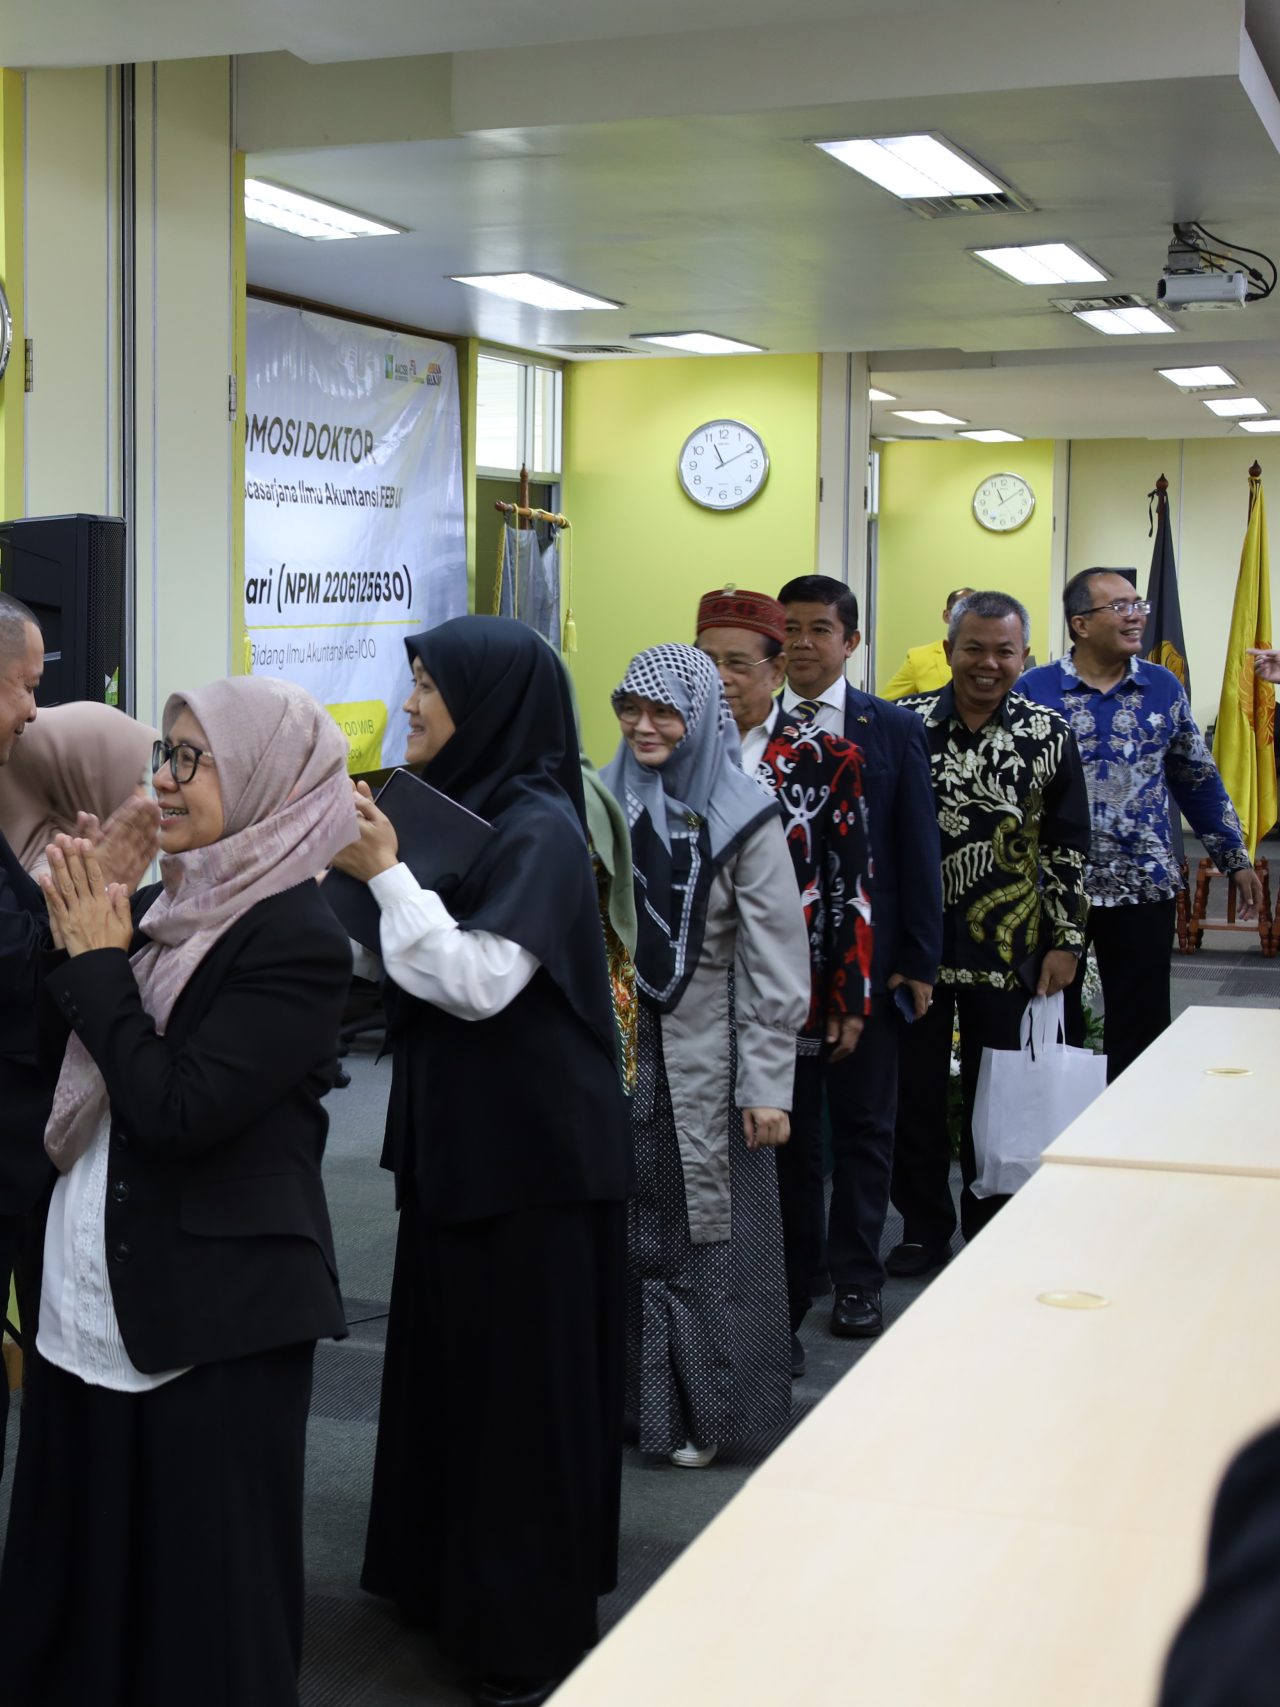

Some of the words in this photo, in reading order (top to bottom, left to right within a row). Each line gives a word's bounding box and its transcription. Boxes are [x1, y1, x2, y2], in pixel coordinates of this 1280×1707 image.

[719, 429, 729, 439] 12
[302, 422, 376, 465] DOKTOR
[693, 445, 704, 455] 10
[689, 460, 698, 470] 9
[750, 459, 759, 469] 3
[298, 480, 323, 504] Ilmu
[324, 482, 379, 508] Akuntansi
[718, 490, 727, 500] 6
[734, 486, 742, 496] 5
[277, 563, 320, 613] (NPM
[322, 564, 412, 609] 2206125630)
[286, 643, 305, 664] Ilmu
